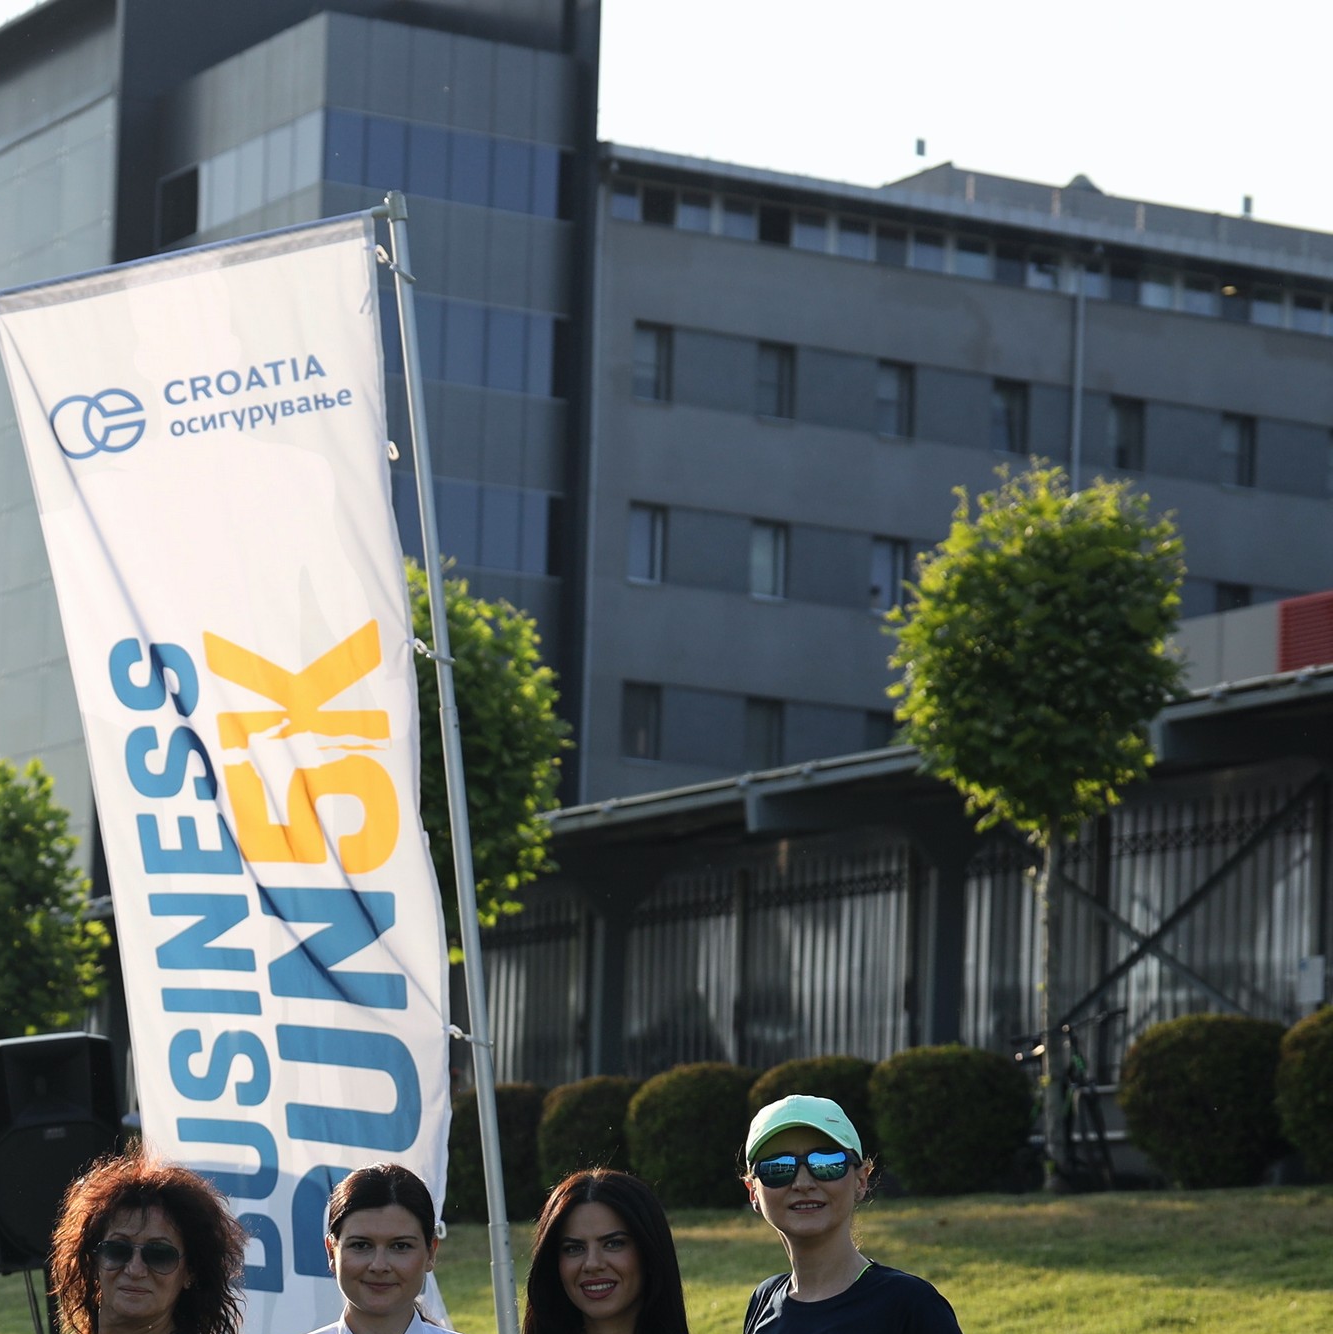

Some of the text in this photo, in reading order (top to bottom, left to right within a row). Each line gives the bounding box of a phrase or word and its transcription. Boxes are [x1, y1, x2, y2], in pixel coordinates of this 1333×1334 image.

[163, 354, 326, 405] CROATIA
[169, 387, 353, 437] осигурување
[108, 636, 284, 1293] BUSINESS
